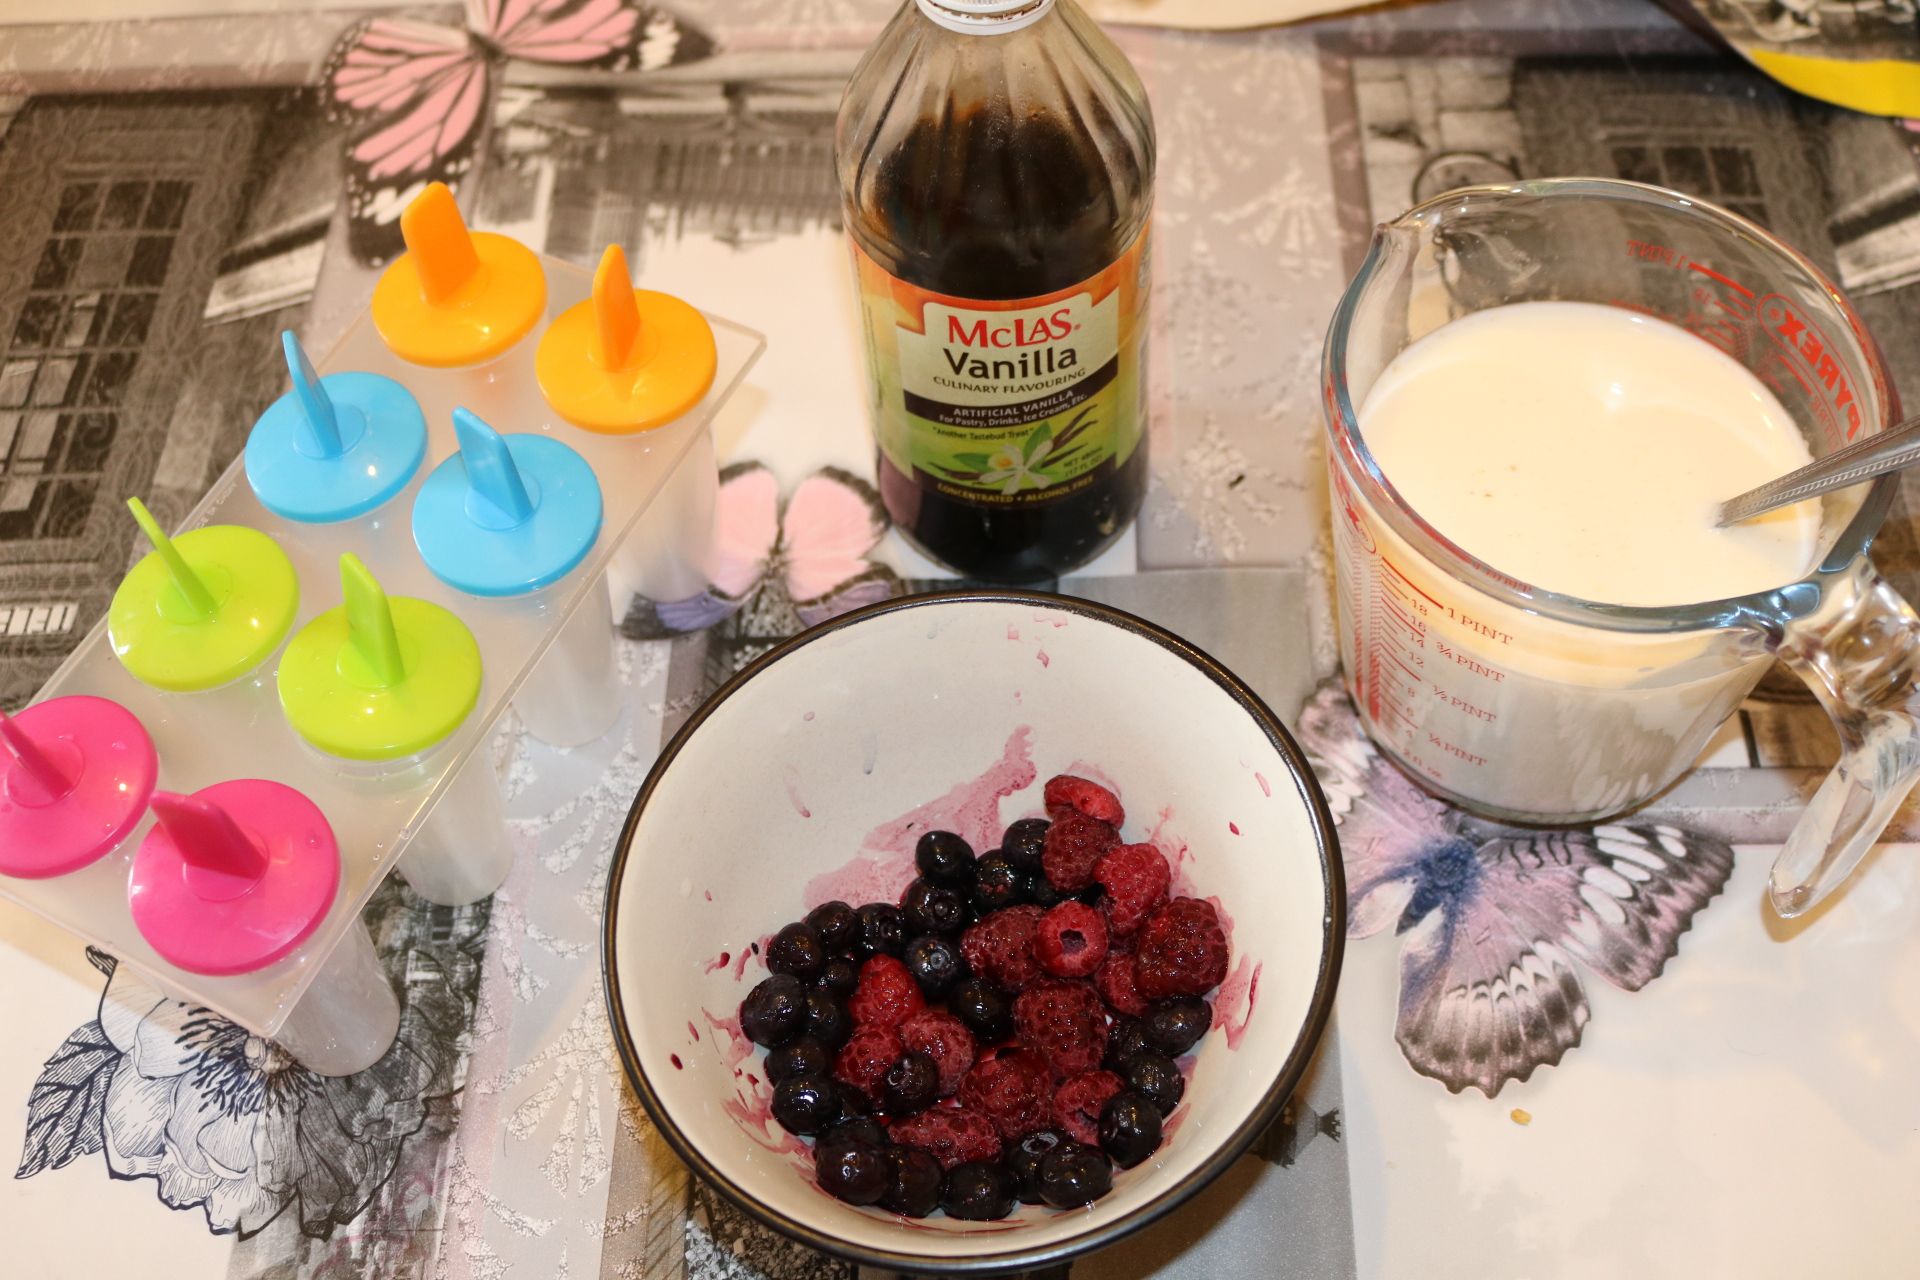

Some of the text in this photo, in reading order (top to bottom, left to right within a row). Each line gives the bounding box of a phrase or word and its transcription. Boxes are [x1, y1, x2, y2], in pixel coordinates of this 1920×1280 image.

[943, 347, 1077, 379] Vanilla
[933, 367, 1086, 394] CULINARY FLAVOURING
[940, 413, 954, 423] For
[956, 417, 987, 428] Pastry,
[989, 415, 1021, 427] Drinks,
[1023, 414, 1037, 422] Ice
[1039, 402, 1070, 418] Cream,
[953, 390, 1073, 418] ARTIFICIAL VANILLA
[937, 483, 1014, 503] CONCENTRATED
[1460, 614, 1513, 645] PINT
[1456, 653, 1505, 682] PINT
[1451, 696, 1497, 722] PINT
[1443, 743, 1488, 766] PINT
